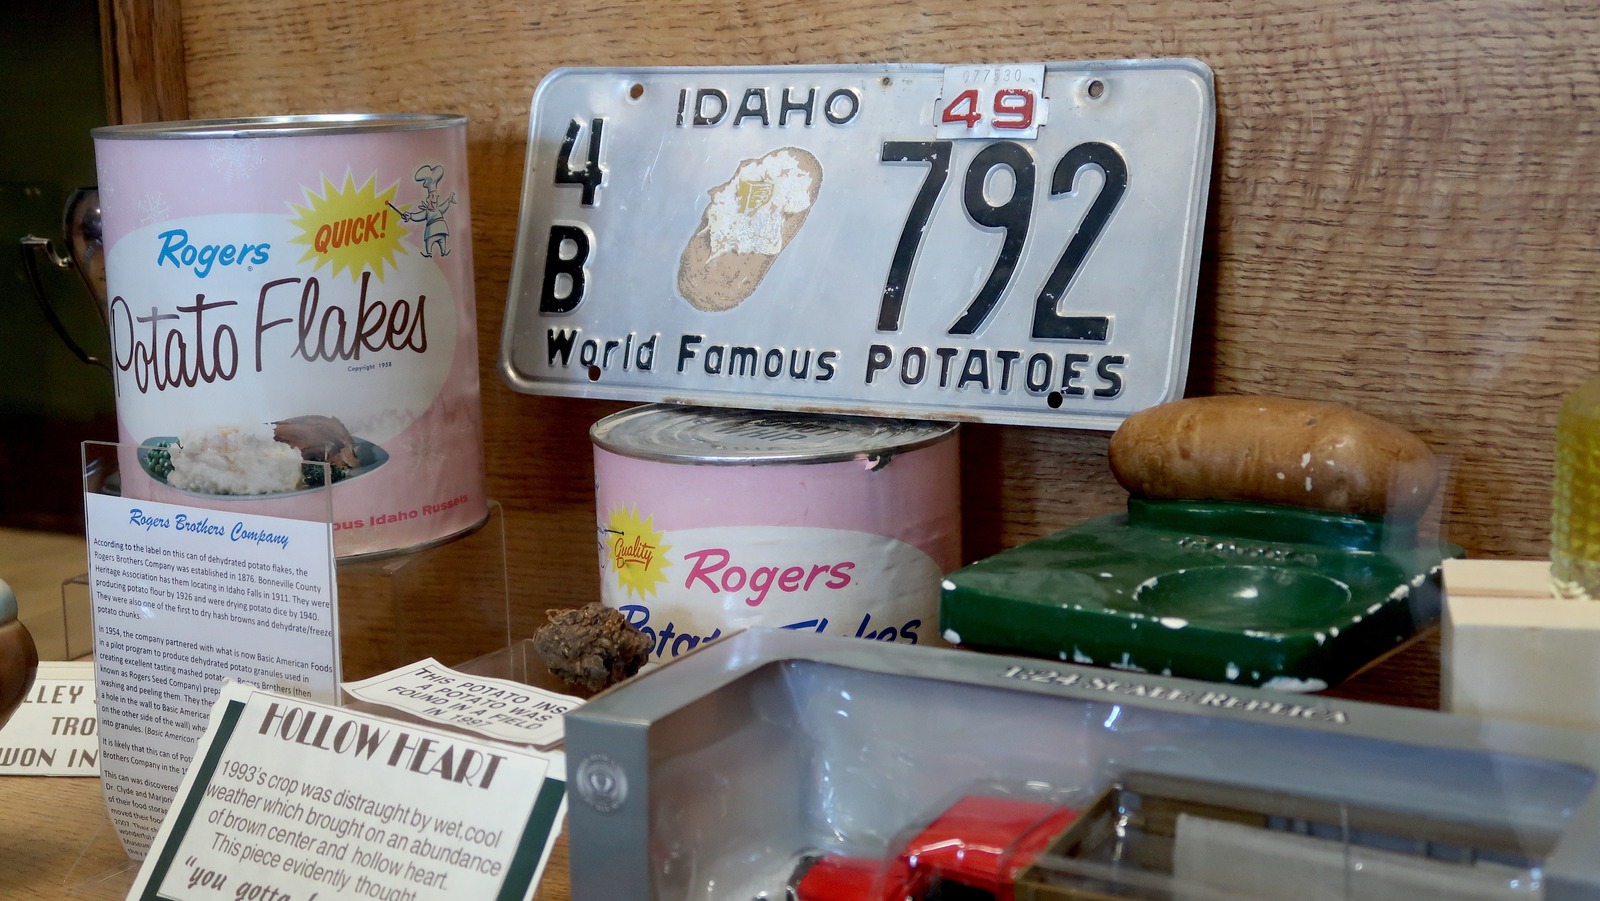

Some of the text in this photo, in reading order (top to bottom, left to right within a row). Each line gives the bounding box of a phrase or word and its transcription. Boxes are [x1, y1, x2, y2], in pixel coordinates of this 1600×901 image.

[676, 88, 860, 127] IDAHO
[942, 89, 1034, 129] 49
[554, 118, 604, 206] 4
[157, 229, 270, 278] Rogers
[314, 210, 388, 254] QUICK!
[877, 141, 1129, 340] 792
[539, 225, 590, 313] B
[110, 272, 428, 397] Potato Flakes
[548, 328, 1125, 398] World Famous POTATOES
[129, 509, 289, 549] Rogers Brothers Company
[370, 509, 418, 527] Idaho
[422, 494, 469, 518] Russets
[94, 538, 124, 551] According
[133, 544, 144, 552] the
[146, 546, 161, 554] label
[172, 550, 185, 558] this
[208, 555, 246, 567] dehydrated
[248, 562, 270, 571] potato
[272, 564, 294, 576] flakes,
[296, 568, 308, 576] the
[94, 551, 114, 561] Rogers
[116, 554, 143, 566] Brothers
[145, 559, 175, 572] Company
[191, 566, 227, 578] established
[238, 573, 256, 583] 1876.
[258, 576, 293, 589] Bonneville
[295, 582, 321, 594] County
[614, 536, 656, 572] Quality
[95, 565, 120, 576] Heritage
[122, 570, 157, 582] Association
[159, 575, 170, 584] has
[172, 578, 189, 587] them
[191, 580, 216, 592] locating
[218, 584, 224, 592] in
[226, 585, 245, 595] Idaho
[247, 589, 261, 598] Falls
[272, 592, 290, 603] 1911.
[292, 596, 309, 607] They
[684, 548, 856, 608] Rogers
[96, 580, 126, 592] producing
[128, 584, 148, 594] potato
[150, 587, 165, 596] flour
[167, 590, 174, 598] by
[176, 592, 192, 601] 1926
[194, 594, 206, 603] and
[227, 600, 247, 611] drying
[249, 604, 271, 614] potato
[273, 607, 287, 616] dice
[289, 609, 297, 619] by
[300, 611, 319, 621] 1940.
[97, 592, 111, 602] They
[129, 598, 141, 606] also
[165, 603, 176, 612] the
[177, 606, 190, 614] first
[200, 609, 211, 619] dry
[213, 611, 228, 620] hash
[230, 614, 255, 625] browns
[257, 619, 270, 627] and
[271, 620, 332, 637] dehydrate/freeze
[98, 606, 141, 619] potato chunks.
[106, 627, 122, 637] 1954,
[135, 633, 164, 645] company
[166, 639, 198, 650] partnered
[199, 644, 213, 652] with
[216, 647, 232, 656] what
[257, 653, 274, 663] Basic
[276, 656, 309, 669] American
[311, 662, 332, 673] Foods
[415, 668, 455, 685] THIS
[457, 682, 530, 704] POTATO
[434, 688, 507, 710] POTATO
[510, 706, 554, 723] WAS
[1001, 666, 1348, 724] 1:24 SCALE REPLICA
[51, 717, 98, 736] TRO
[388, 686, 544, 730] FOUND IN A FIELD
[423, 708, 444, 717] IN
[0, 748, 98, 768] WON IN
[258, 702, 507, 790] HOLLOW HEART
[104, 770, 117, 779] This
[144, 779, 178, 792] discovered
[106, 783, 115, 791] Dr.
[117, 786, 133, 795] Clyde
[222, 760, 267, 786] 1993's
[268, 775, 298, 796] crop
[301, 783, 332, 803] was
[334, 789, 410, 824] distraught
[410, 808, 432, 833] by
[207, 783, 502, 877] weather which brought on an abundance
[208, 809, 448, 890] of brown center and hollow heart.
[212, 832, 416, 901] This piece evidently thought
